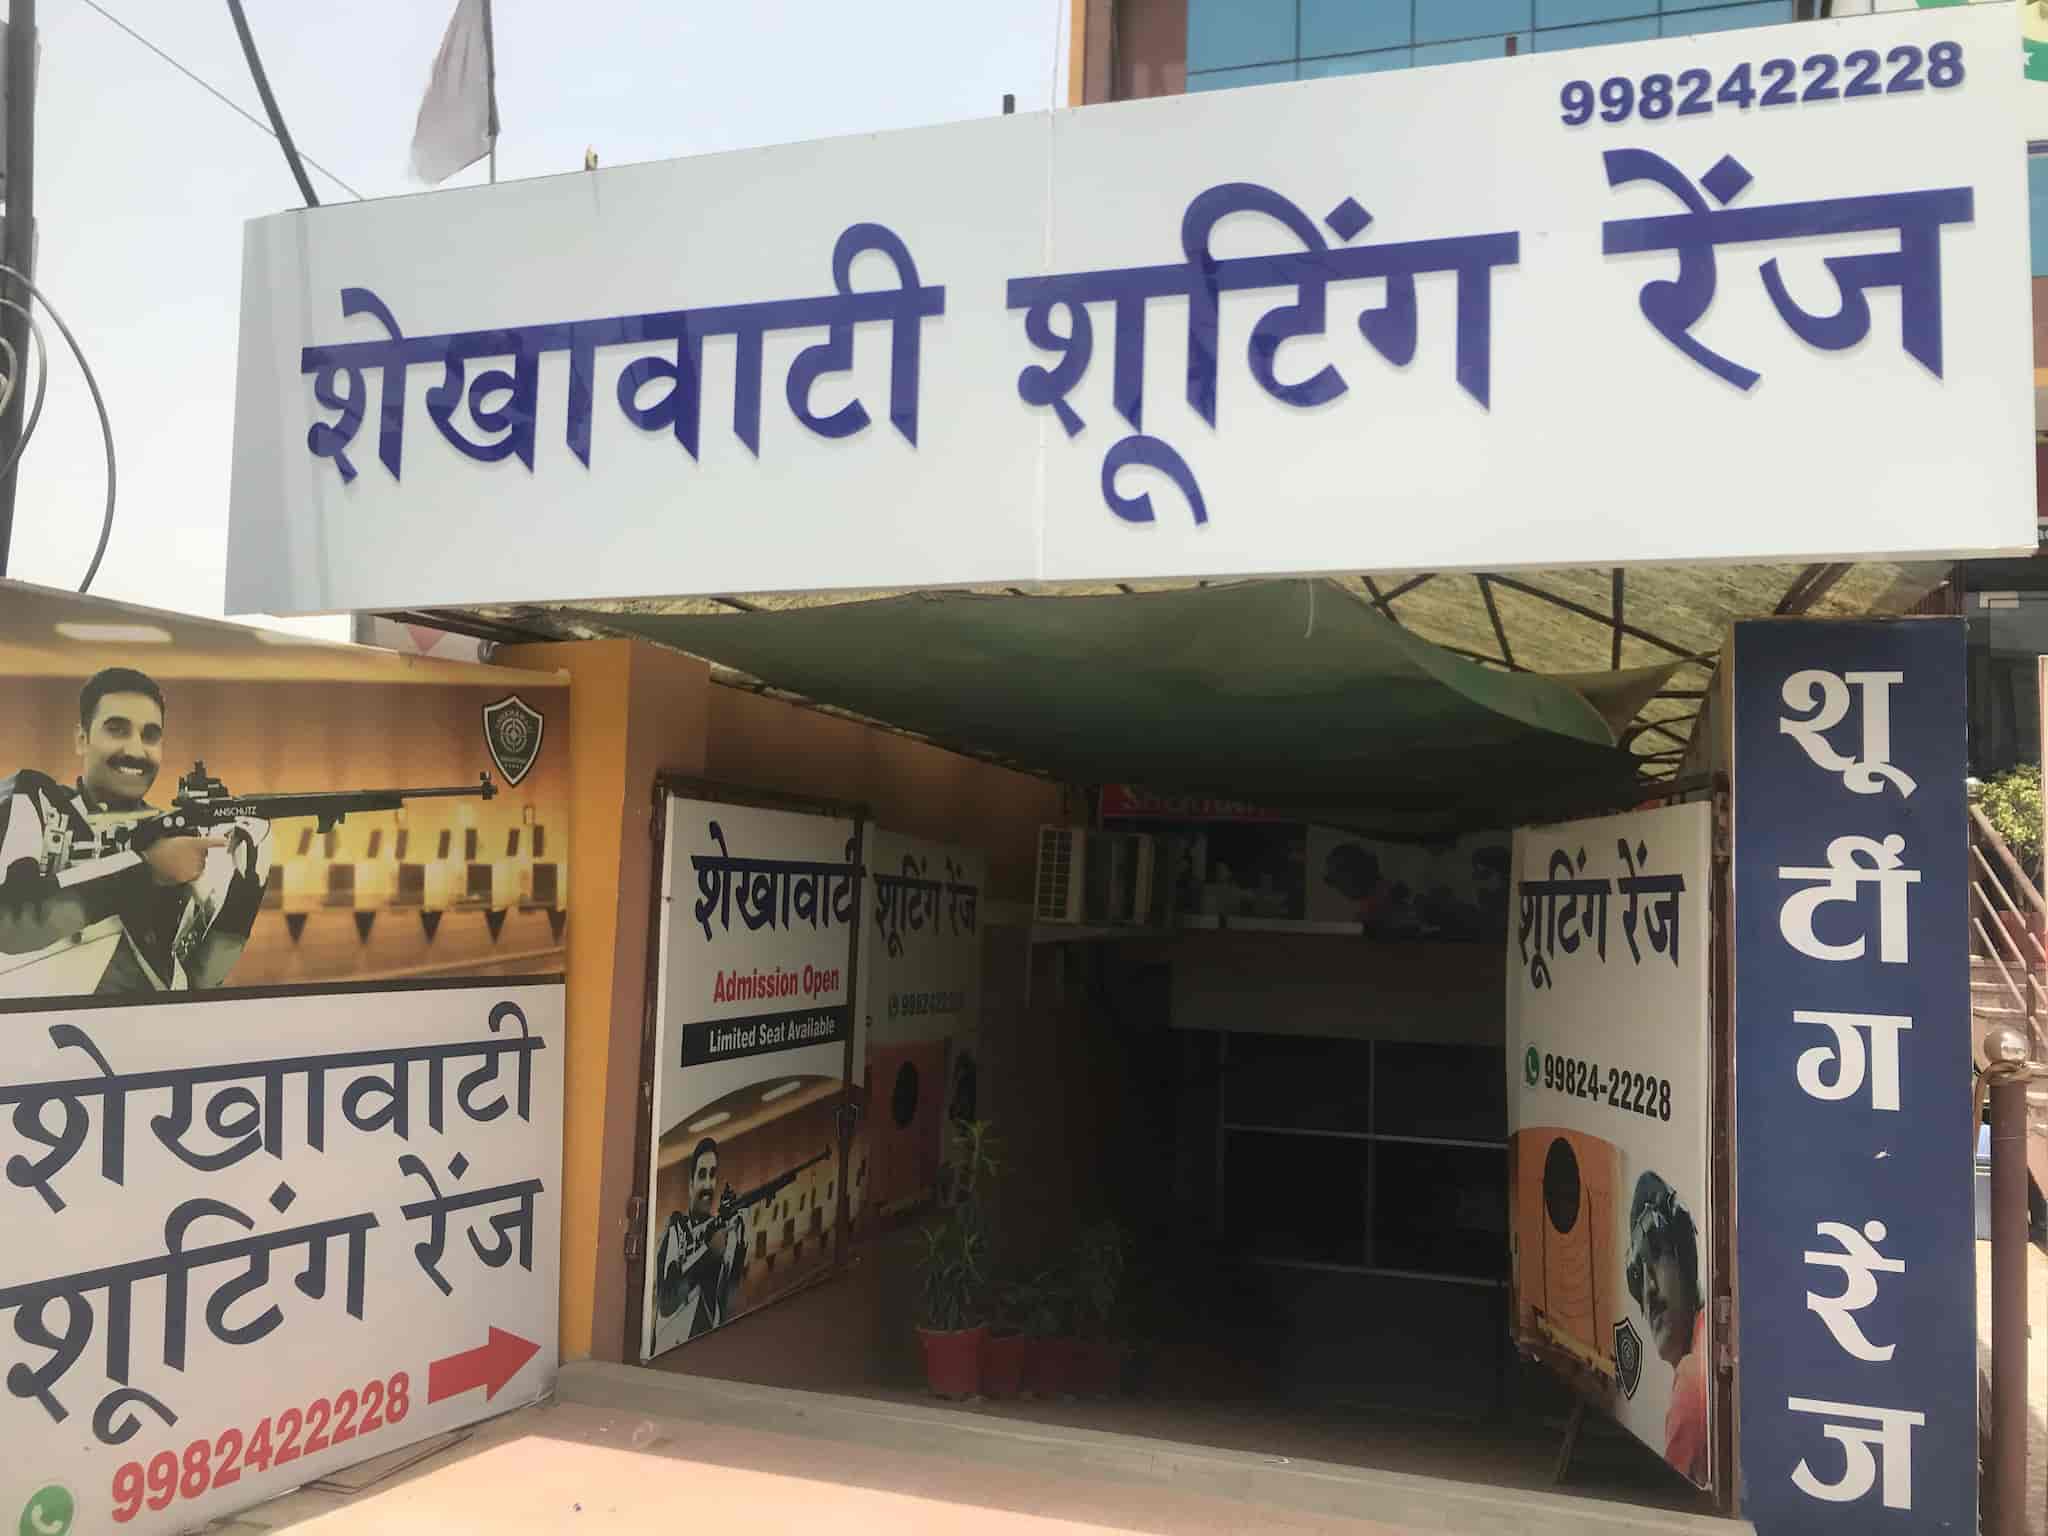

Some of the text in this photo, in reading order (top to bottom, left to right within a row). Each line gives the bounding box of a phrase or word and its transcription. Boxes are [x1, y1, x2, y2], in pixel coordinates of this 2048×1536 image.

[1560, 40, 1965, 127] 9982422228
[301, 148, 1974, 526] शेखावाटी शूटिंग रेंज
[713, 964, 840, 1003] Admission Open
[1518, 838, 1686, 989] शूटिंग रेंज
[0, 1001, 546, 1214] शेखावाटी
[709, 1015, 836, 1054] Limited Seat Available
[1543, 1053, 1672, 1122] 99824-22228
[0, 1151, 544, 1446] शूटिंग रेंज
[112, 1371, 411, 1523] 9982422228
